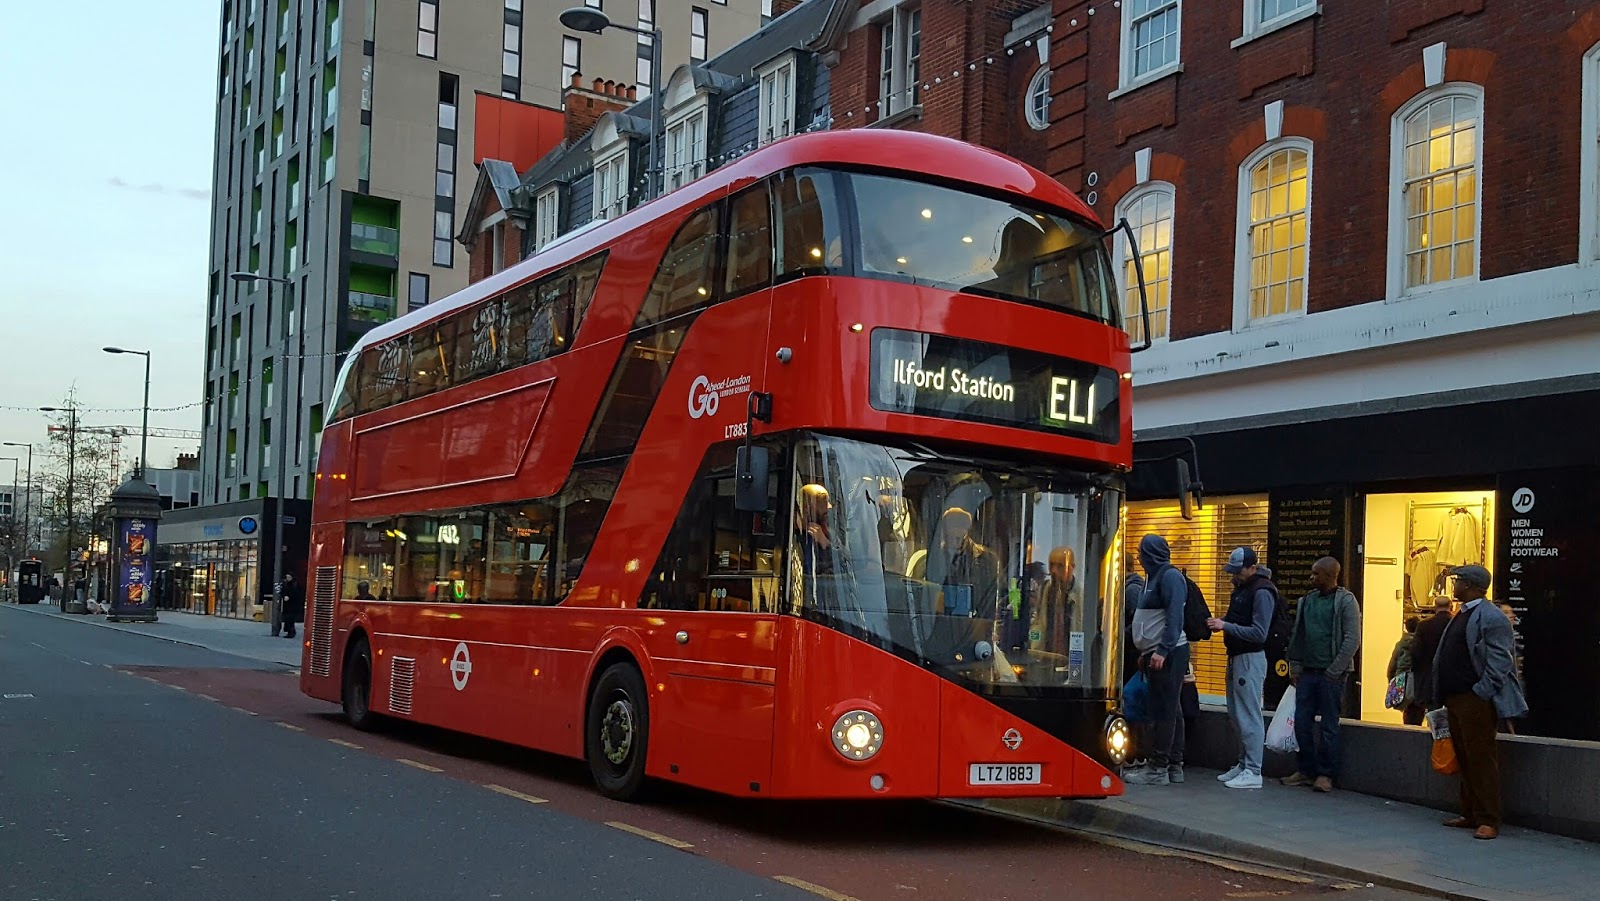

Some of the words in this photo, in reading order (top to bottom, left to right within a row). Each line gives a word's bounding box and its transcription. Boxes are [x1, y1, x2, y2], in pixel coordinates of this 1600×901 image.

[893, 358, 945, 390] Ilford
[950, 368, 1014, 402] Station
[688, 375, 719, 419] Go
[1050, 376, 1096, 425] EL1
[724, 422, 748, 439] LT883
[1515, 493, 1532, 507] JD
[1511, 519, 1531, 528] MEN
[1511, 528, 1544, 537] WOMEN
[1510, 538, 1541, 547] JUNIOR
[1510, 548, 1559, 557] FOOTWEAR
[978, 766, 1003, 782] LTZ
[1006, 766, 1033, 782] 1883
